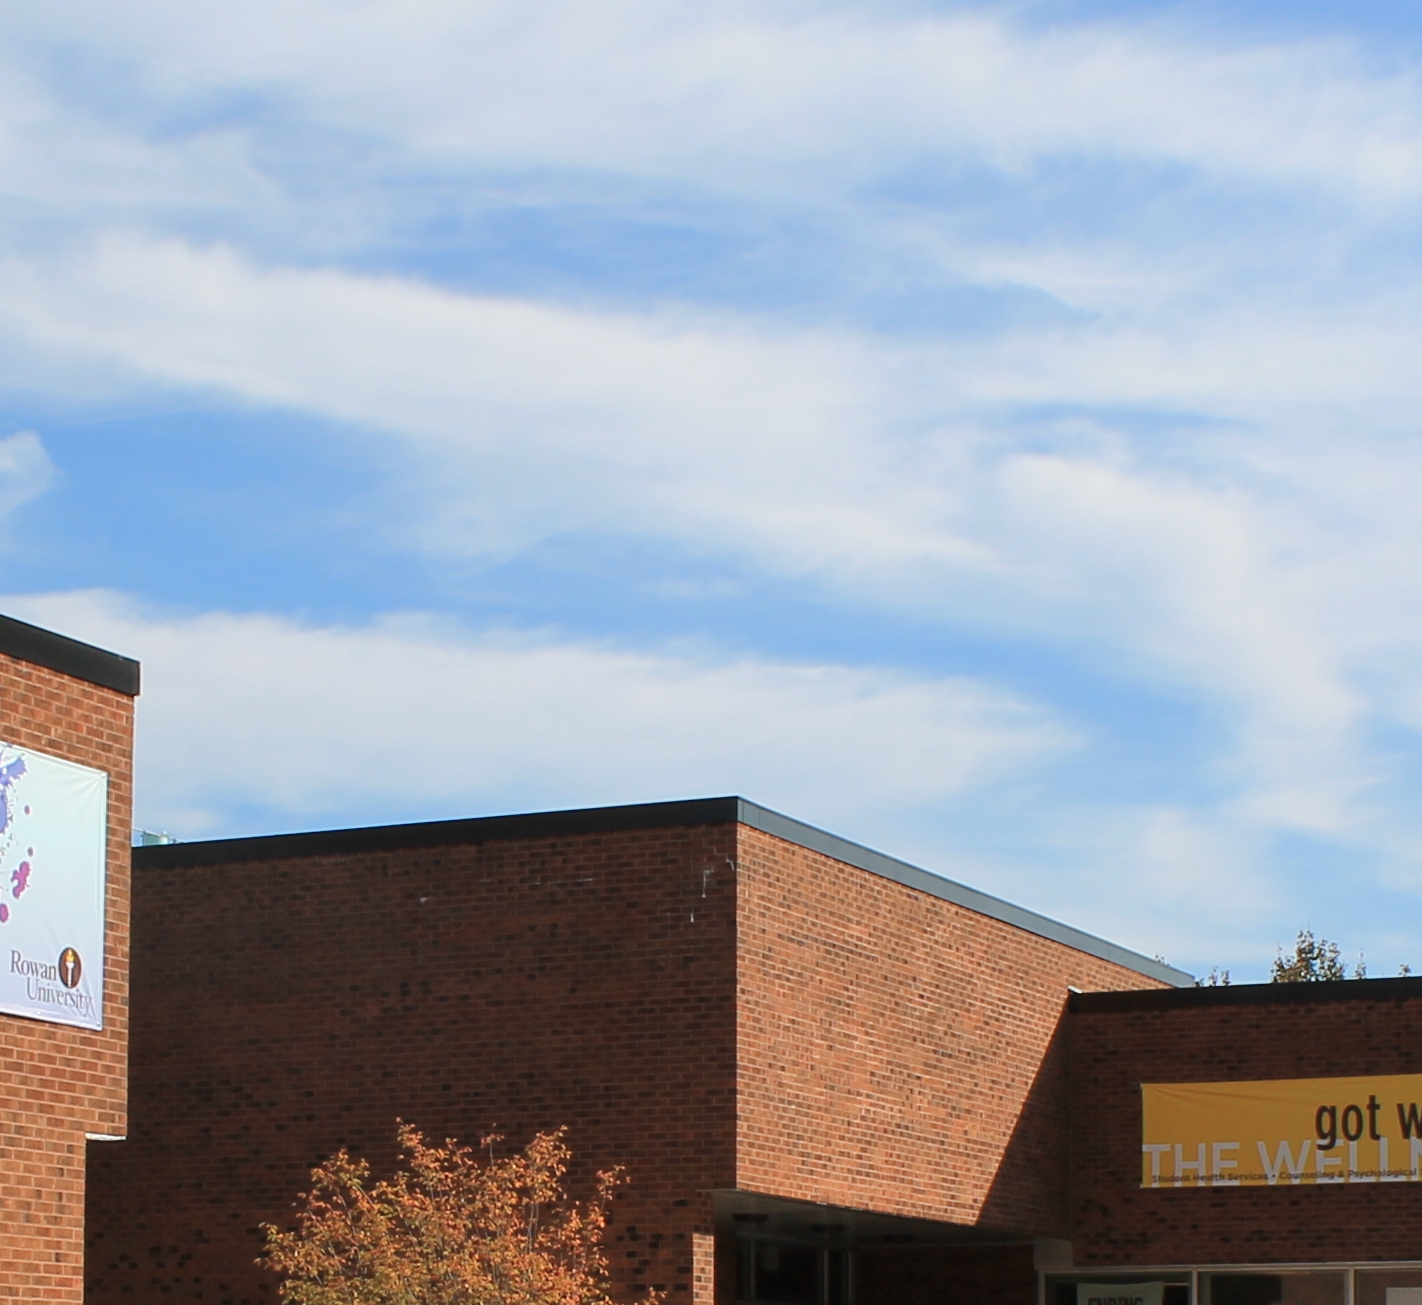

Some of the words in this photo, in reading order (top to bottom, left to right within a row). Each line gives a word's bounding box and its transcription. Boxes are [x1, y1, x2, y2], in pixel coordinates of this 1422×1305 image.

[9, 949, 58, 982] Rowan
[26, 976, 94, 1018] University
[1314, 1094, 1382, 1151] got
[1142, 1140, 1241, 1188] THE
[1151, 1173, 1191, 1183] Student
[1193, 1172, 1226, 1182] Health
[1228, 1171, 1269, 1181] Services
[1279, 1169, 1335, 1181] Counseling
[1347, 1167, 1417, 1179] Psychological
